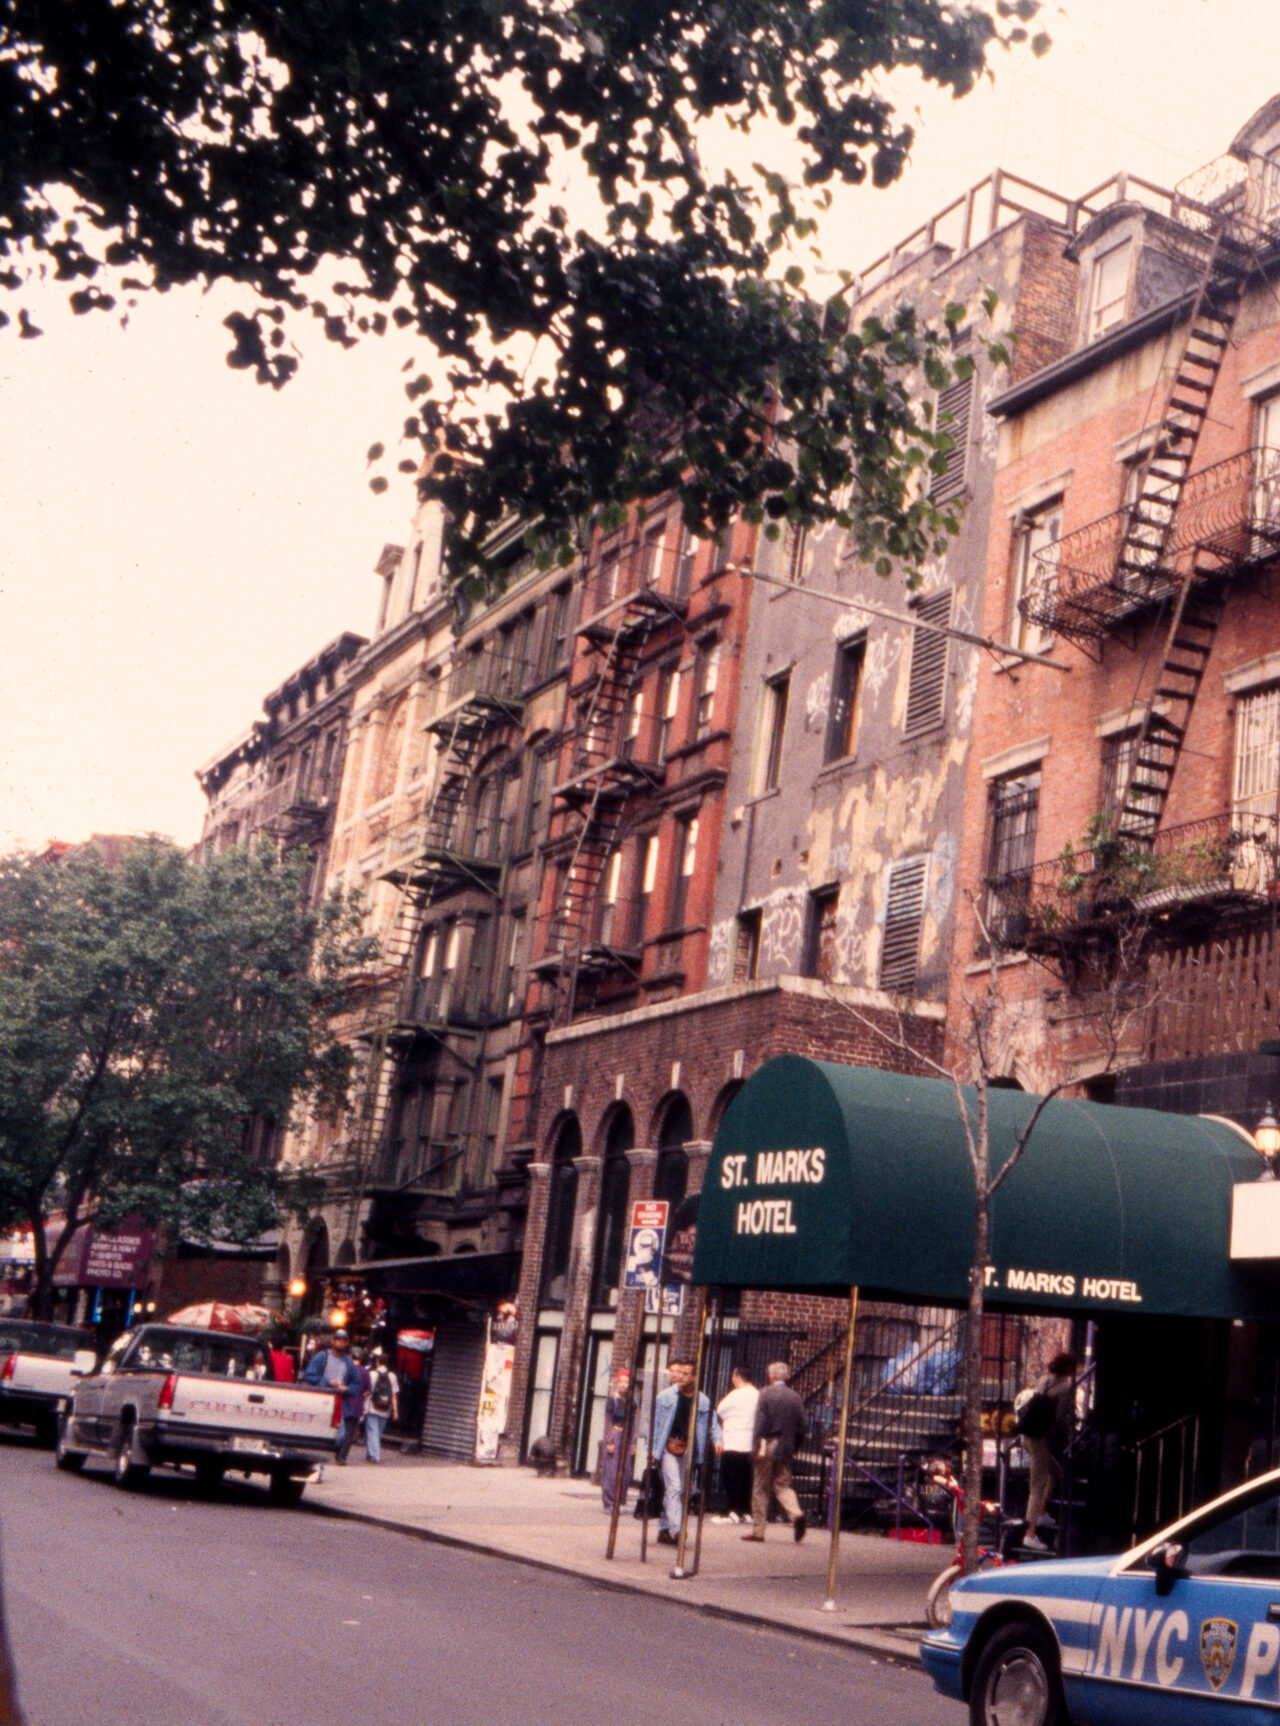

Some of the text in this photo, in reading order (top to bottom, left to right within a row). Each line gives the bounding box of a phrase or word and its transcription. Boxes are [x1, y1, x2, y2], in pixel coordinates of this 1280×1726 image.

[721, 1147, 826, 1189] ST. MARKS
[645, 1203, 657, 1211] NO
[736, 1199, 798, 1236] HOTEL
[1006, 1269, 1076, 1296] MARKS
[1082, 1278, 1143, 1302] HOTEL
[189, 1400, 317, 1424] CHEVROLET
[1093, 1605, 1190, 1687] NYC
